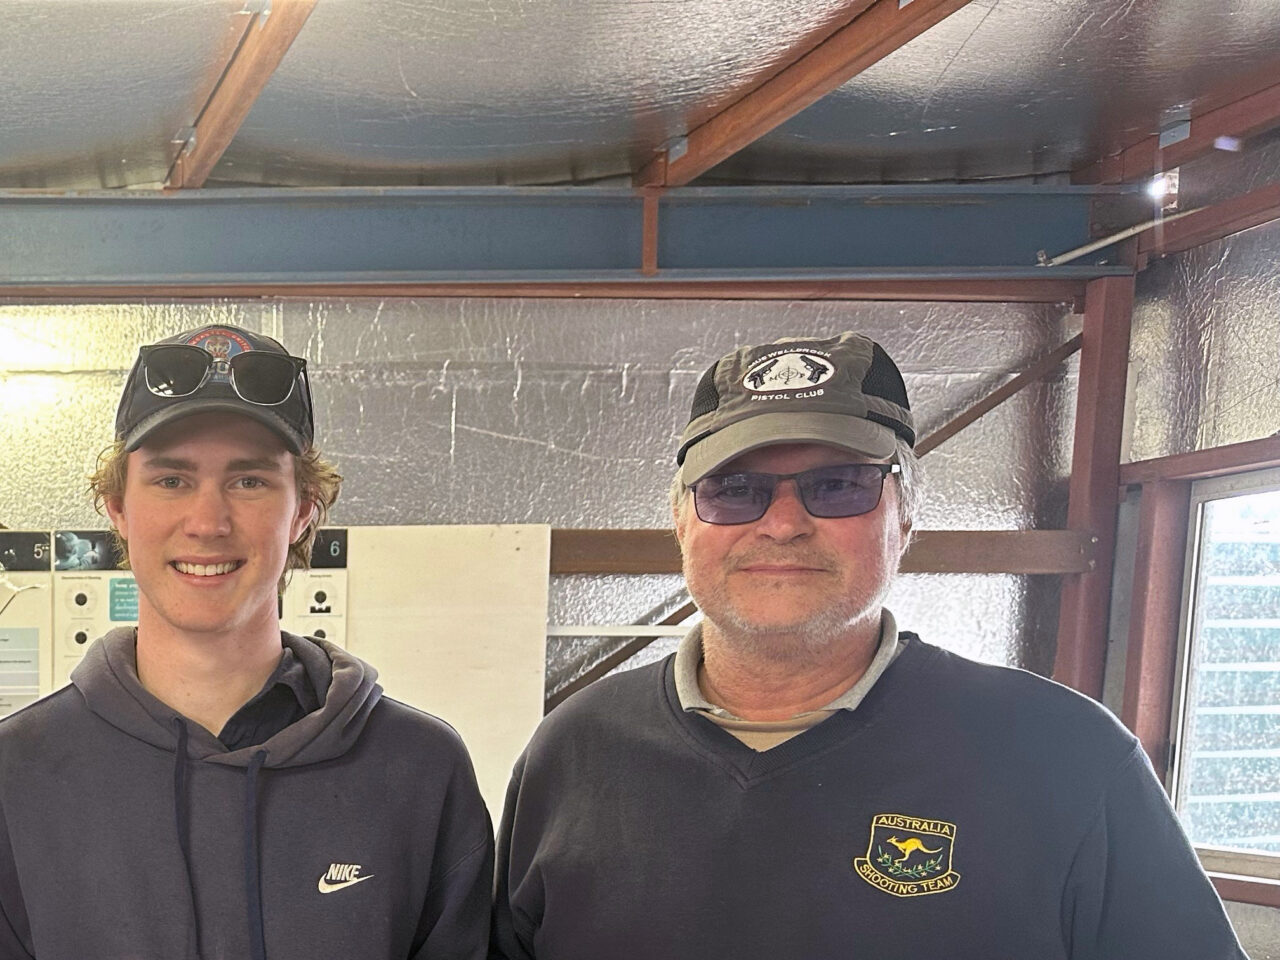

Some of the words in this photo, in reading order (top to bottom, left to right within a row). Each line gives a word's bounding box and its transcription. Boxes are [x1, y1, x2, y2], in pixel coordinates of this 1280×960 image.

[751, 393, 790, 401] PISTOL
[795, 388, 825, 399] CLUB
[34, 543, 43, 559] 5
[330, 541, 340, 556] 6
[878, 816, 951, 835] AUSTRALIA
[326, 863, 361, 881] NIKE
[860, 864, 918, 894] SHOOTING
[921, 876, 954, 892] TEAM
